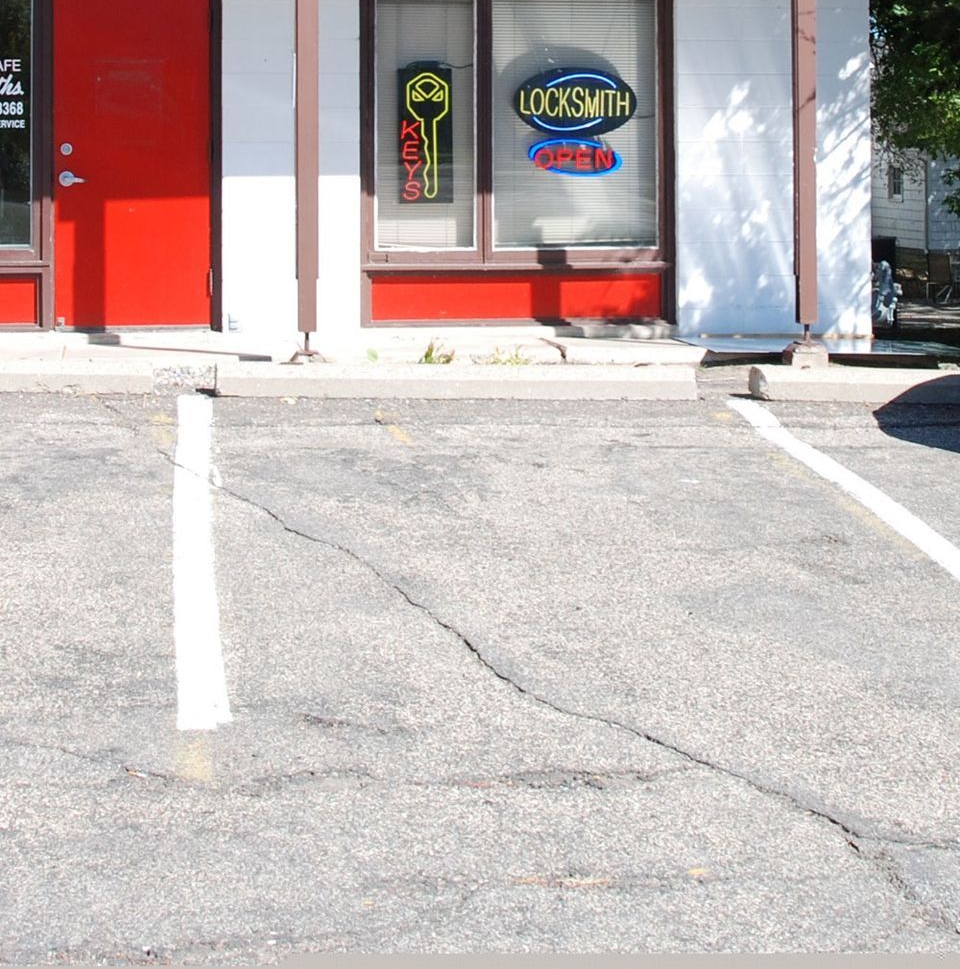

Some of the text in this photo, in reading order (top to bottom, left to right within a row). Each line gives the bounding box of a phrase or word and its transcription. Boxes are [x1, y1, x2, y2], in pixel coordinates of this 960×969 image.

[519, 86, 630, 118] LOCKSMITH
[400, 120, 421, 201] KEYS
[533, 148, 614, 170] OPEN
